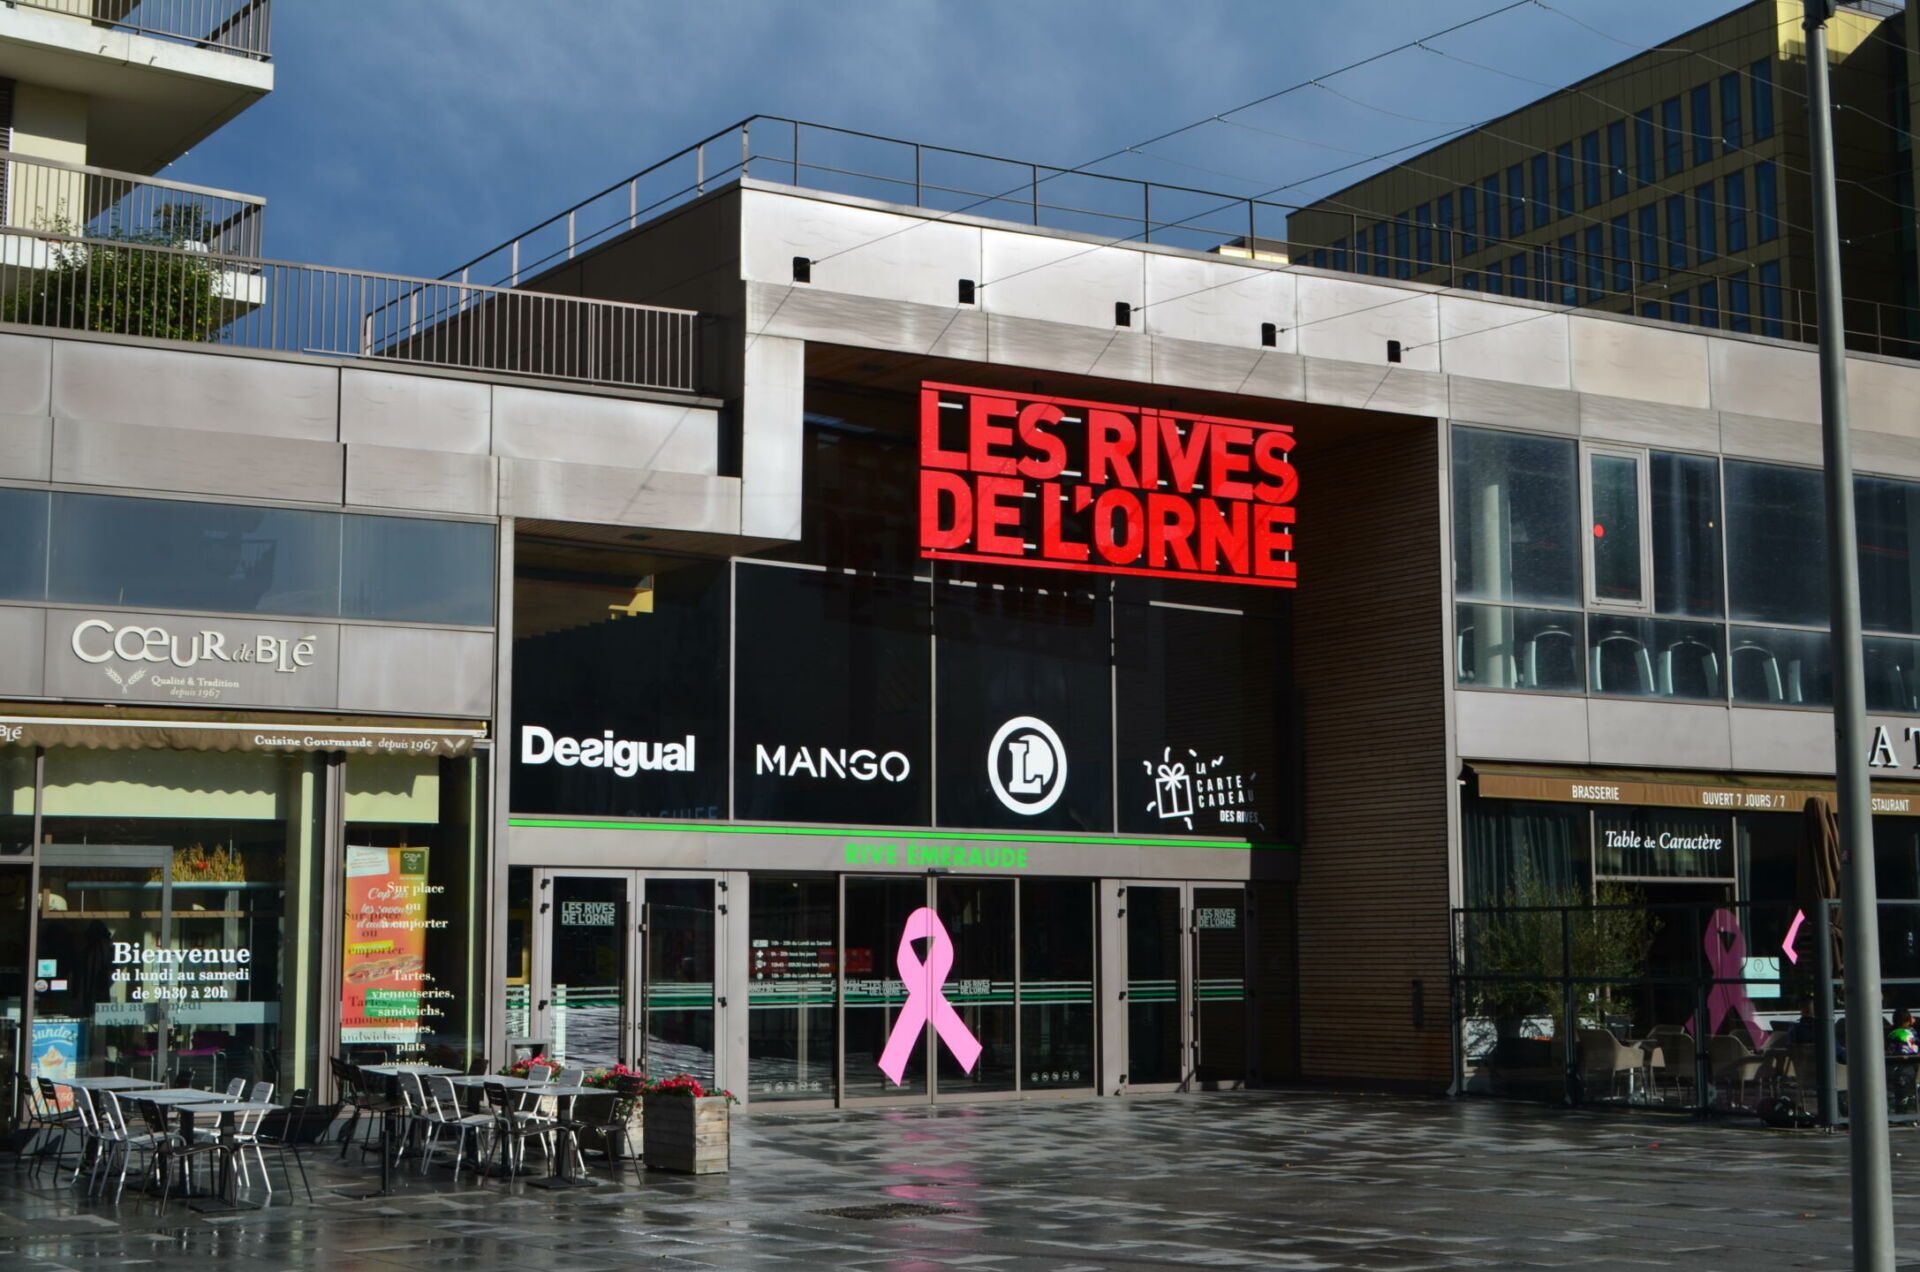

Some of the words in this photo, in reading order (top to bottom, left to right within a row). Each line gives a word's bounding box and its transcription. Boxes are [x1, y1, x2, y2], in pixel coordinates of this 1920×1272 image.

[920, 389, 1068, 480] LES
[1087, 408, 1299, 505] RIVES
[920, 469, 1025, 556] DE
[1043, 481, 1297, 579] L'ORNE
[231, 643, 256, 663] de
[151, 675, 185, 687] Qualité
[187, 677, 195, 686] &
[196, 677, 240, 688] Tradition
[170, 686, 196, 698] depuis
[198, 688, 221, 699] 1967
[254, 735, 301, 746] Cuisine
[303, 736, 373, 748] Gourmande
[378, 737, 409, 750] depuis
[411, 739, 438, 751] 1967
[1868, 725, 1920, 769] AT
[521, 725, 696, 778] Desigual
[756, 744, 911, 783] MANGO
[1195, 762, 1207, 775] LA
[1196, 775, 1242, 793] CARTE
[1198, 790, 1254, 808] CADEAU
[1571, 785, 1620, 801] BRASSERIE
[1702, 791, 1734, 806] OUVERT
[1737, 793, 1742, 806] 7
[1744, 794, 1772, 808] JOURS
[1780, 795, 1786, 808] 7
[1872, 798, 1910, 813] STAURANT
[1219, 810, 1235, 822] DES
[1236, 811, 1258, 823] RIVES
[1605, 830, 1641, 848] Table
[1644, 837, 1656, 849] de
[1659, 832, 1722, 850] Caractère
[845, 842, 898, 865] RIVE
[906, 840, 1028, 868] ÉMERAUDE
[387, 881, 409, 893] Sur
[413, 882, 445, 896] place
[405, 903, 421, 911] ou
[562, 901, 582, 913] LES
[584, 901, 616, 914] RIVES
[1214, 908, 1236, 919] RIVES
[390, 919, 449, 932] emporter
[561, 913, 576, 925] DE
[578, 913, 615, 926] L'ORNE
[112, 942, 250, 964] Bienvenue
[111, 969, 131, 981] du
[135, 969, 174, 981] lundi
[177, 971, 195, 981] au
[199, 968, 249, 981] samedi
[392, 969, 436, 982] Tartes,
[131, 987, 150, 999] de
[154, 987, 187, 999] 9h30
[191, 986, 200, 999] à
[203, 986, 229, 999] 20h
[371, 987, 455, 999] viennoiseries,
[378, 1004, 445, 1017] sandwichs,
[396, 1041, 426, 1055] plats
